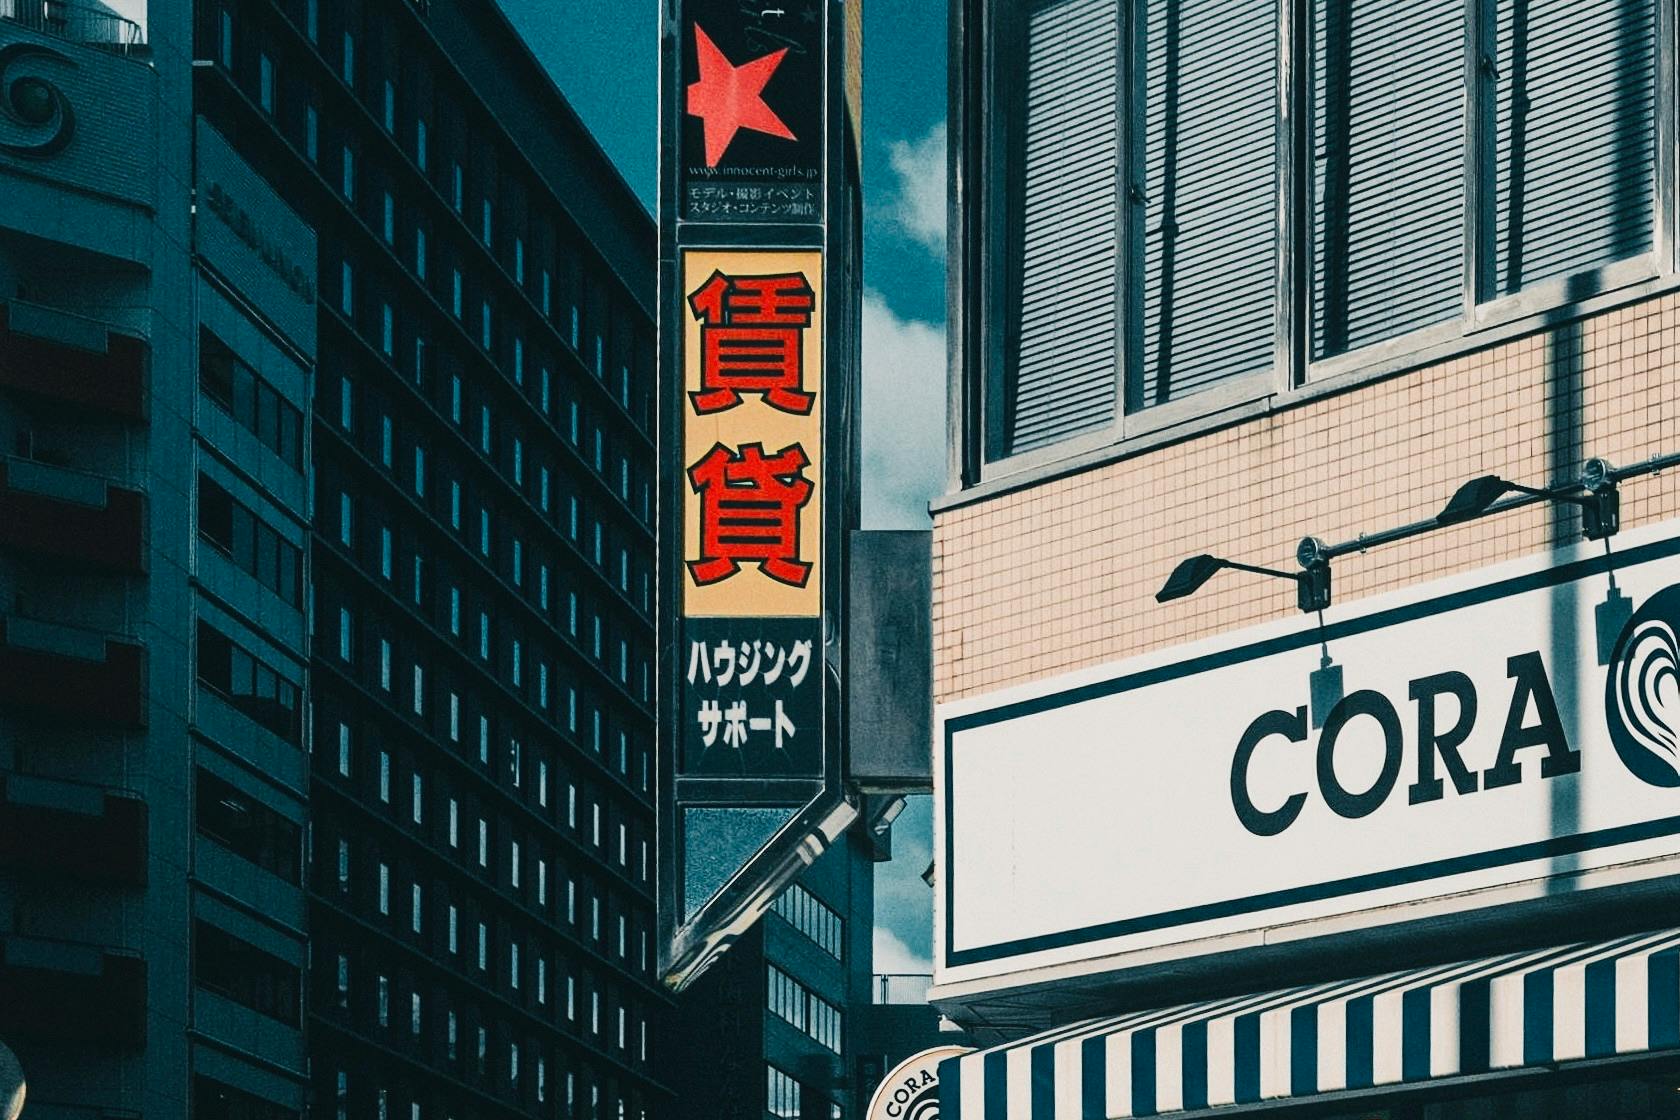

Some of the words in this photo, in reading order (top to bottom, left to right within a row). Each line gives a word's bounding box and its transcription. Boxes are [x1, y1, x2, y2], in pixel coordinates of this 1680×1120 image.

[685, 269, 816, 589] 賃貸
[688, 639, 812, 687] ハウジング
[698, 700, 795, 748] サポート
[1230, 651, 1580, 836] CORA
[886, 1069, 936, 1118] CORA
